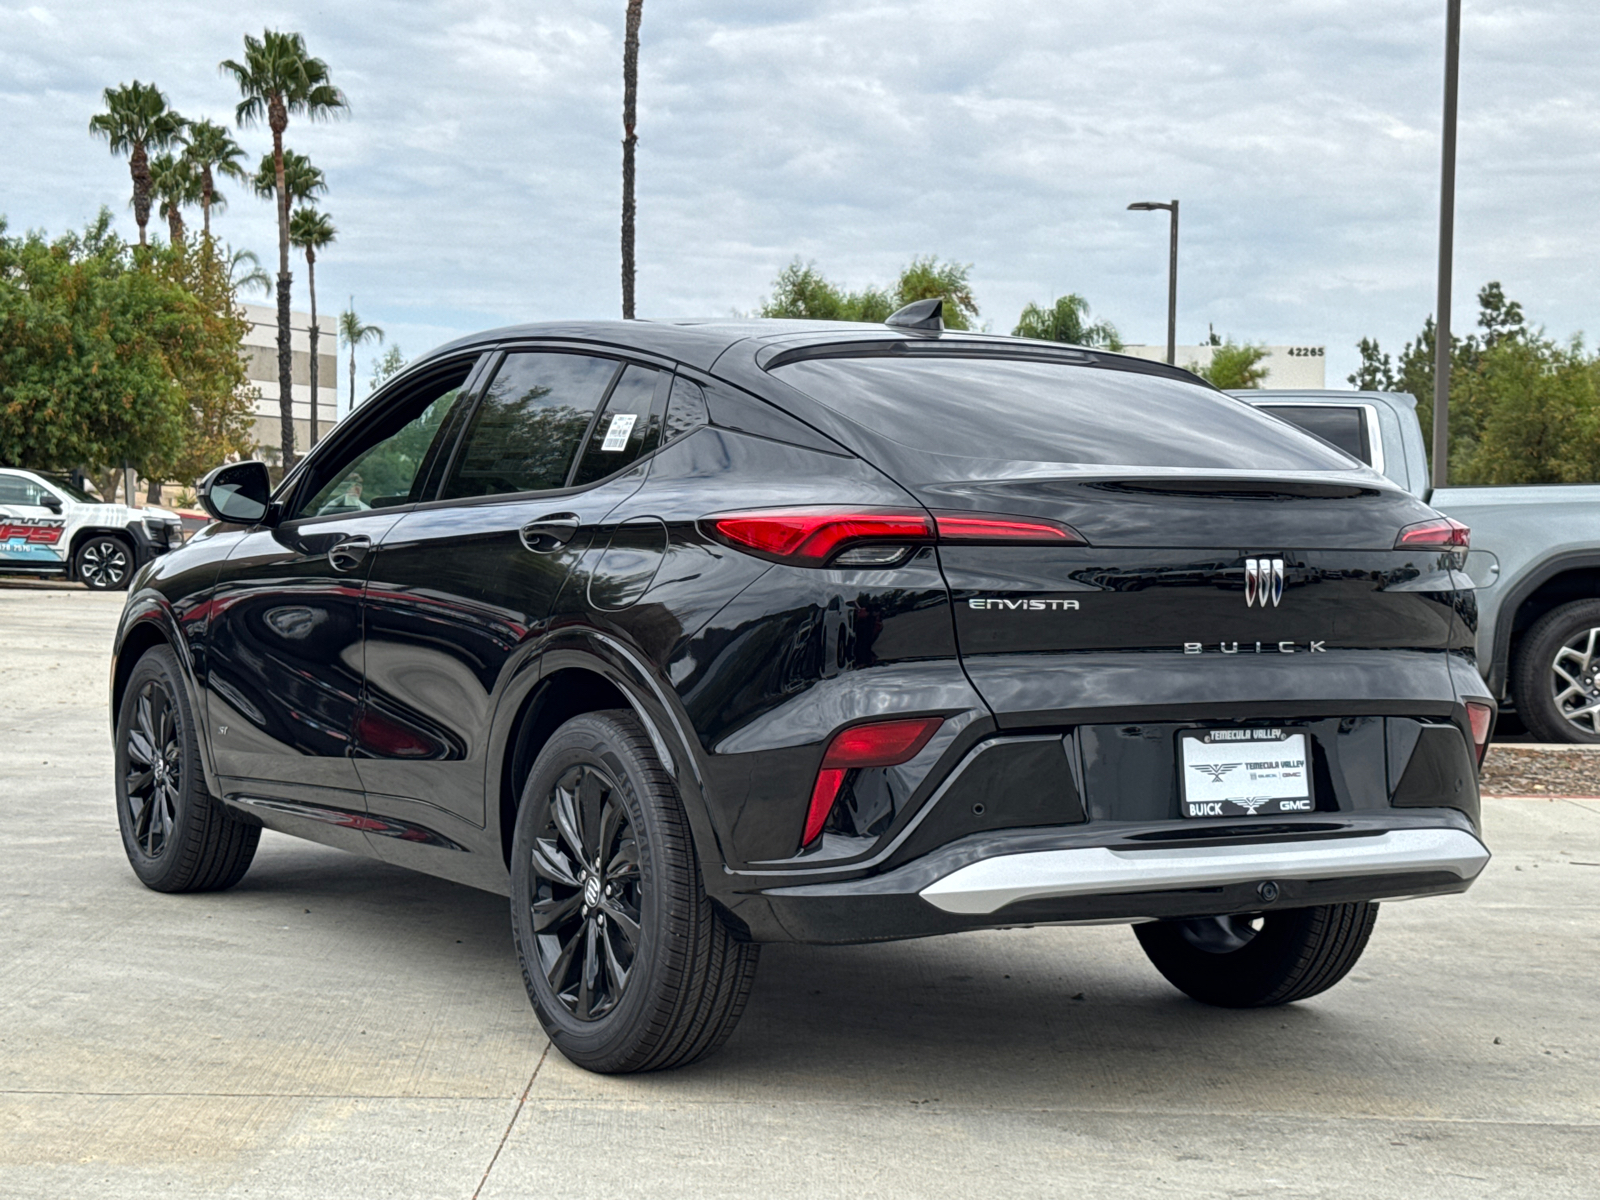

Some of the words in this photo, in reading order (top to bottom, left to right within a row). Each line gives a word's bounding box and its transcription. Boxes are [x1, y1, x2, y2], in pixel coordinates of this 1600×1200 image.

[1287, 347, 1325, 357] 42265
[968, 599, 1080, 611] ENVISTA
[1183, 641, 1327, 655] BUICK
[1210, 730, 1251, 740] TEMECULA
[1253, 729, 1281, 739] VALLEY
[1245, 761, 1280, 770] TEMECULA
[1281, 760, 1304, 768] VALLEY
[1189, 803, 1223, 816] BUICK
[1280, 800, 1311, 810] GMC
